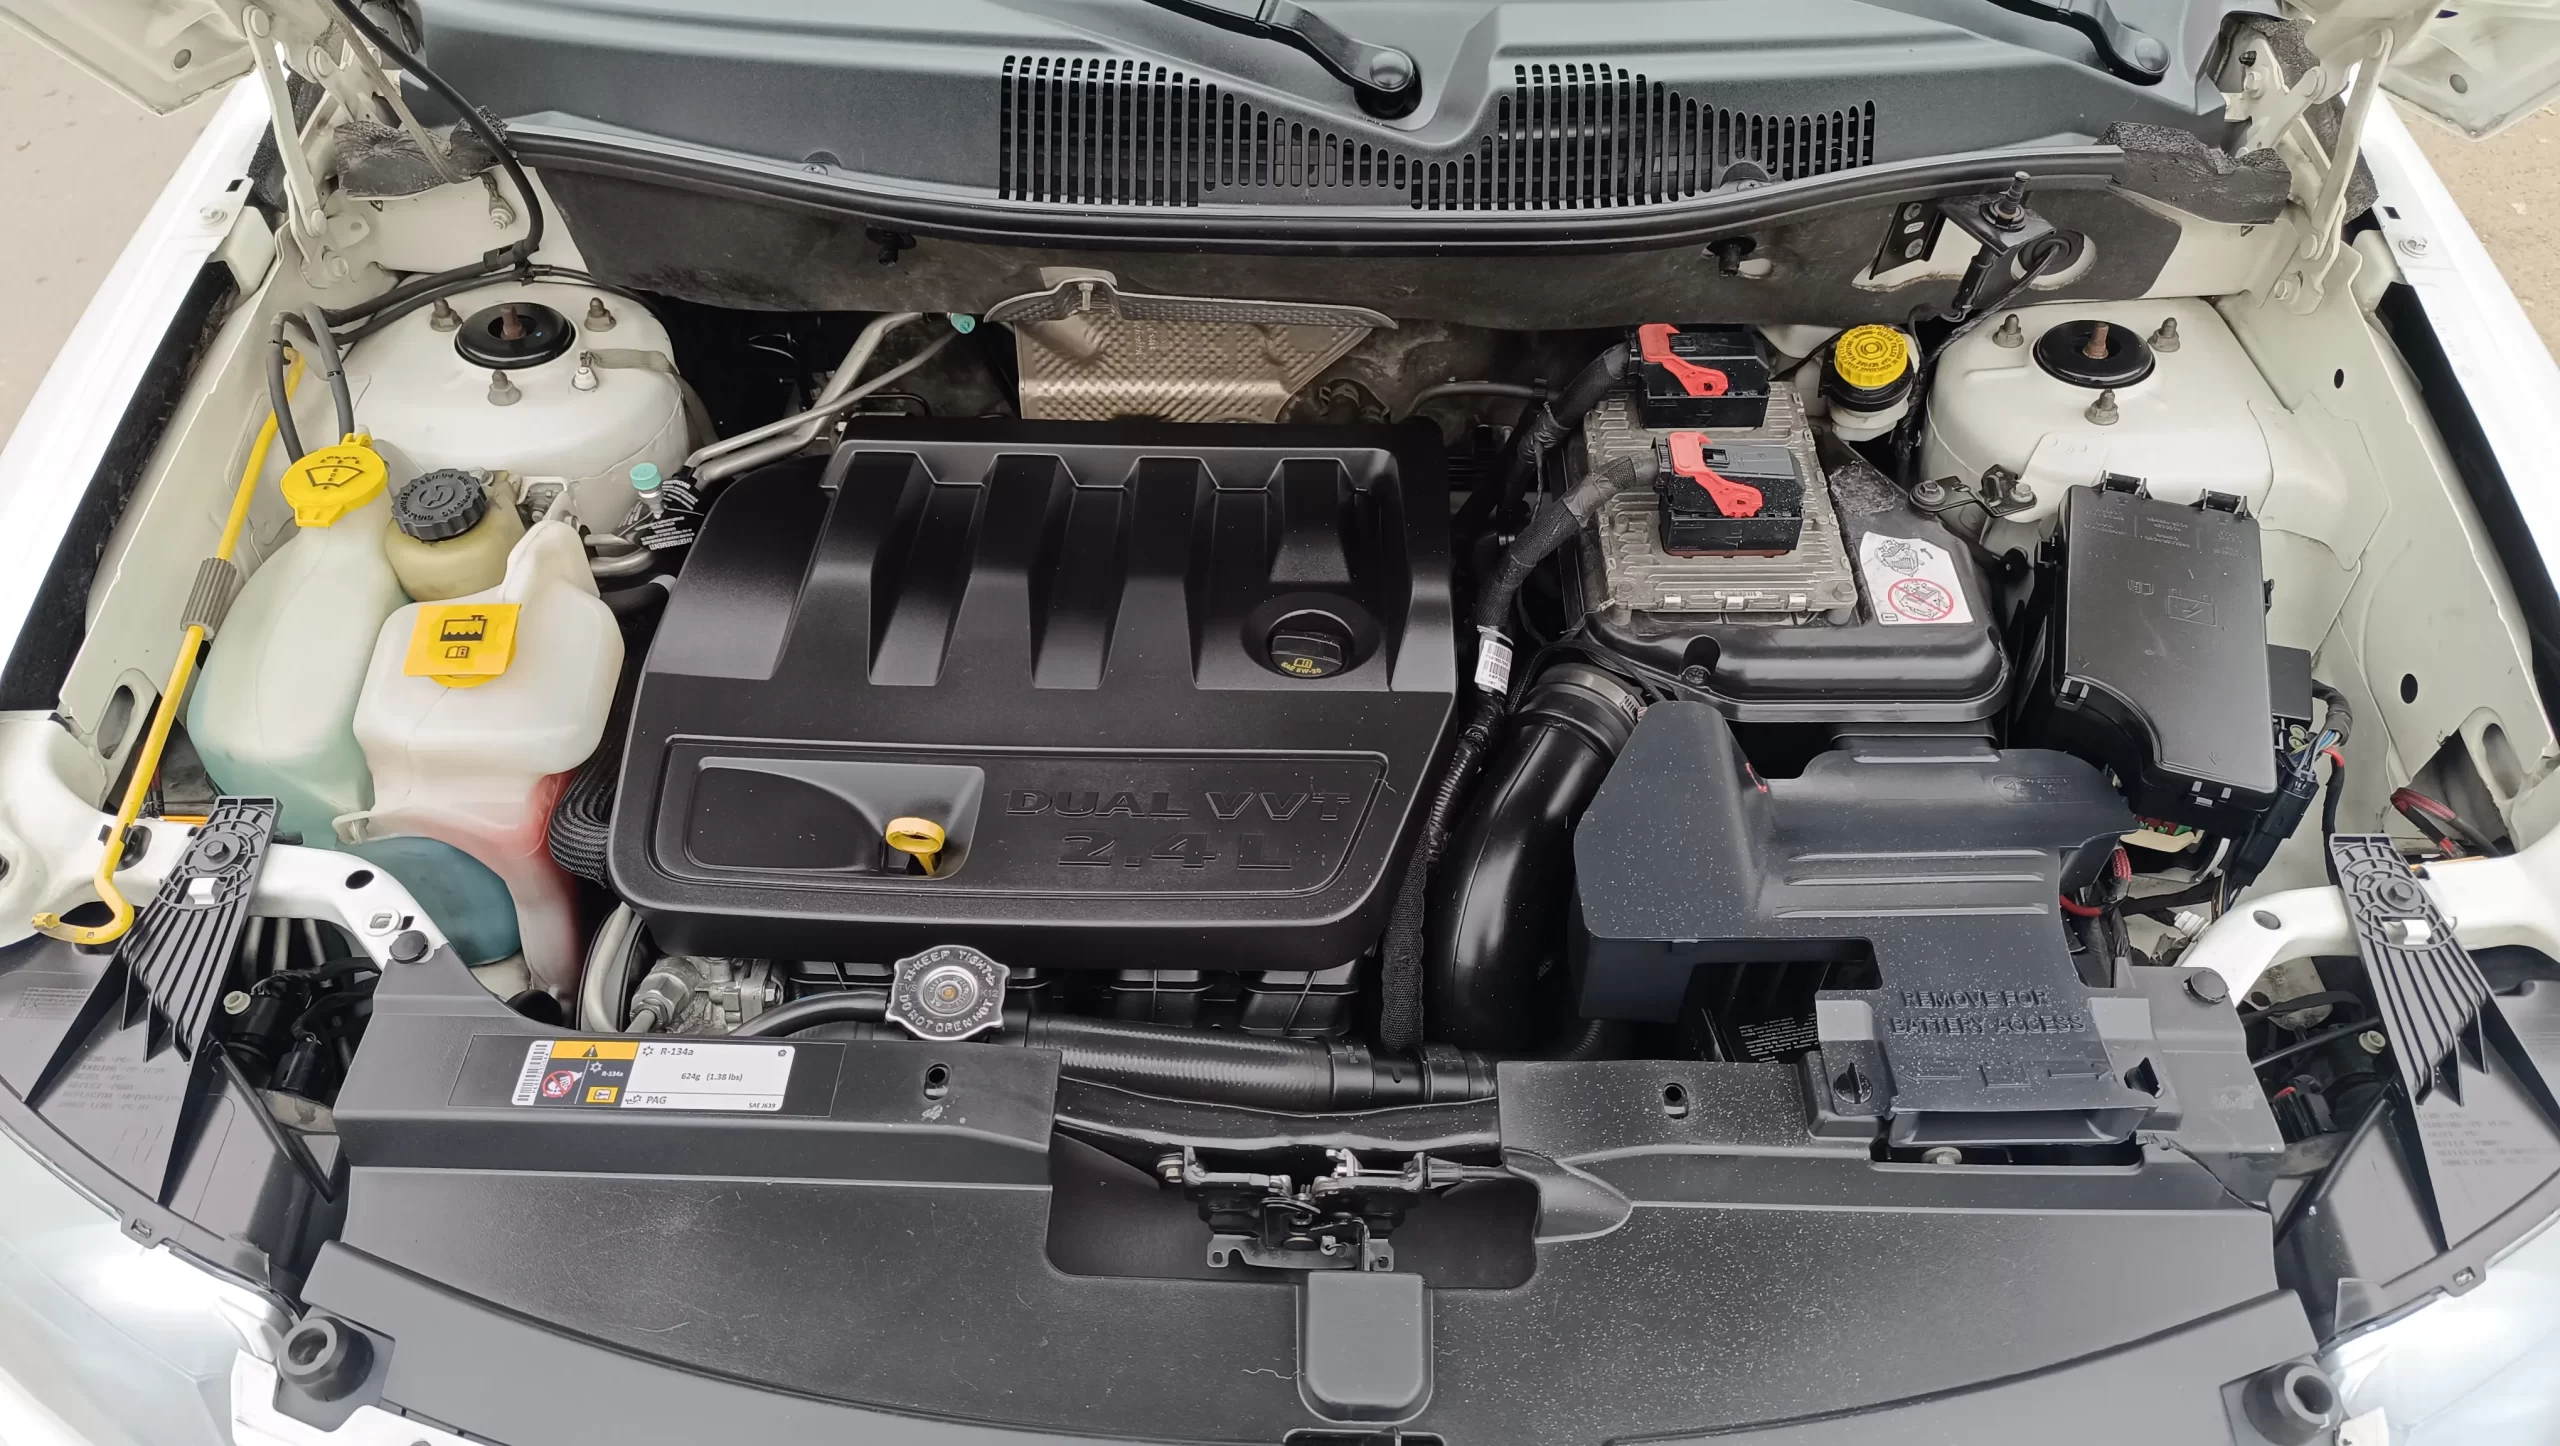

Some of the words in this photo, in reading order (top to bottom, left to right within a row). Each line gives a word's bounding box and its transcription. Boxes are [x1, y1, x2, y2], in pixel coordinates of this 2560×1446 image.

[1006, 789, 1189, 819] DUAL
[1205, 792, 1351, 821] VVT
[980, 988, 998, 997] K12
[1901, 990, 2000, 1009] REMOVE
[2003, 990, 2051, 1009] FOR
[1889, 1016, 1987, 1035] BATTERY
[1995, 1014, 2086, 1035] ACCESS
[660, 1047, 694, 1056] R-134a
[681, 1072, 701, 1081] 624g
[706, 1073, 727, 1081] (1.38
[728, 1073, 743, 1082] lbs)
[646, 1096, 667, 1104] PAG
